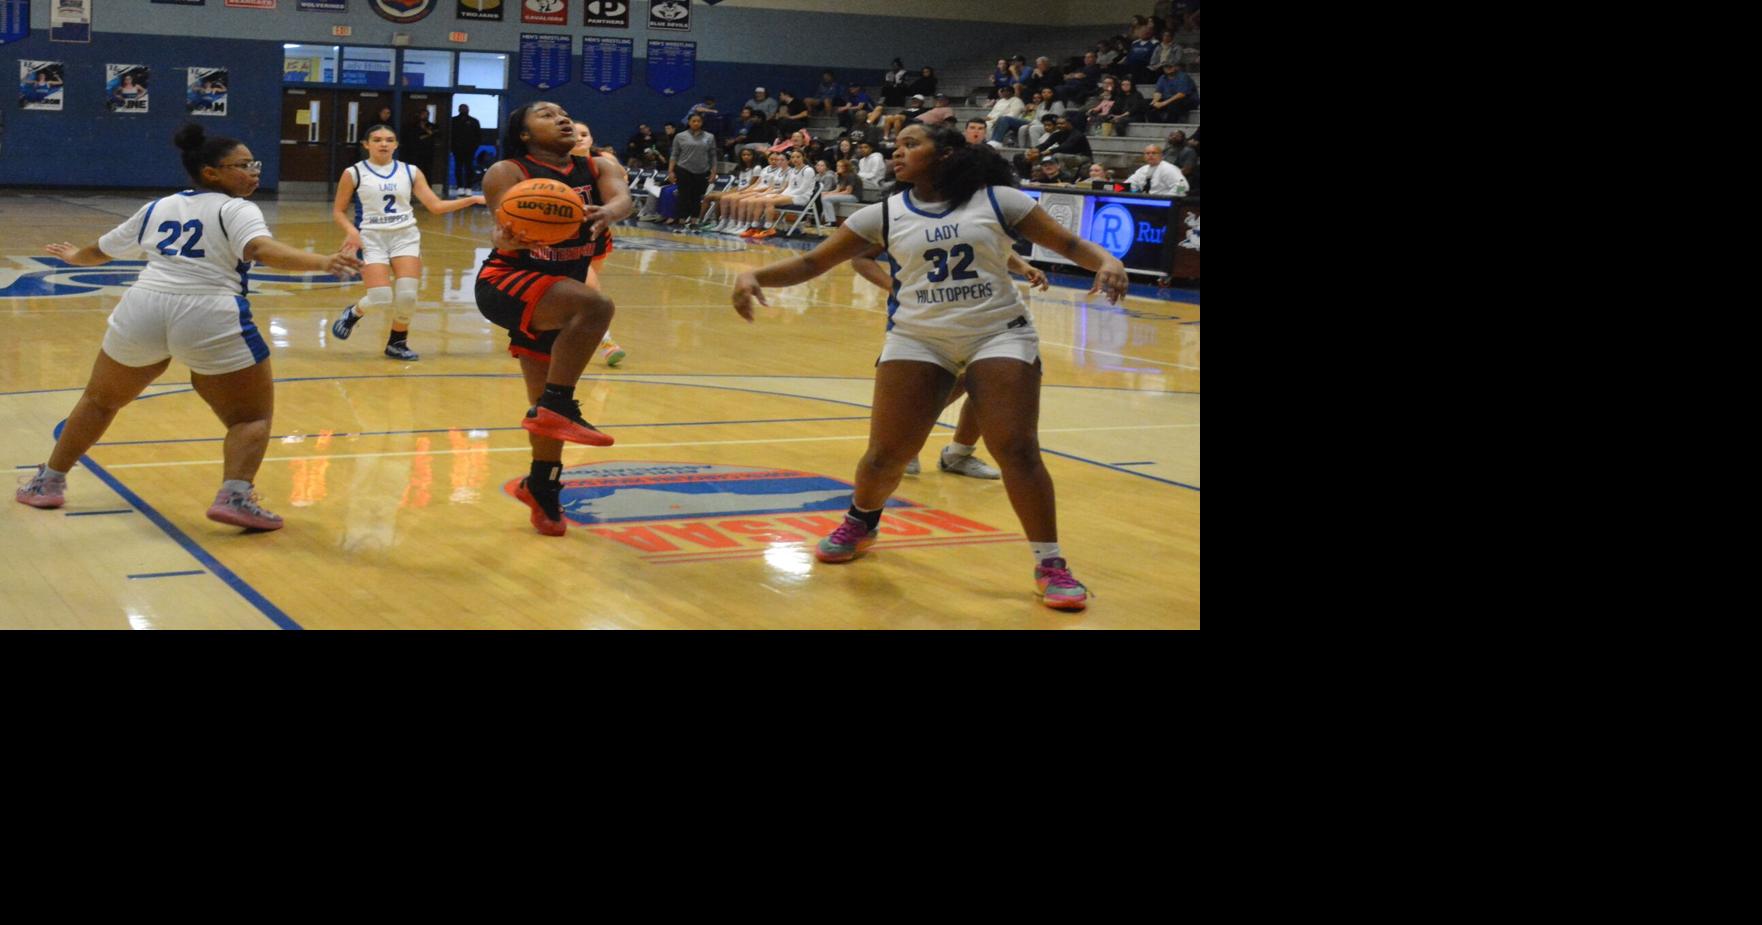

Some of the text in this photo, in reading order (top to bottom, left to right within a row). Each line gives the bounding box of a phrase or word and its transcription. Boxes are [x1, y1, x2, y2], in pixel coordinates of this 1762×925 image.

[383, 194, 397, 214] 2
[517, 200, 574, 218] Wilson
[156, 218, 205, 258] 22
[925, 223, 959, 243] LADY
[1102, 214, 1123, 249] R
[923, 243, 979, 283] 32
[915, 282, 993, 304] HILLTOPPERS
